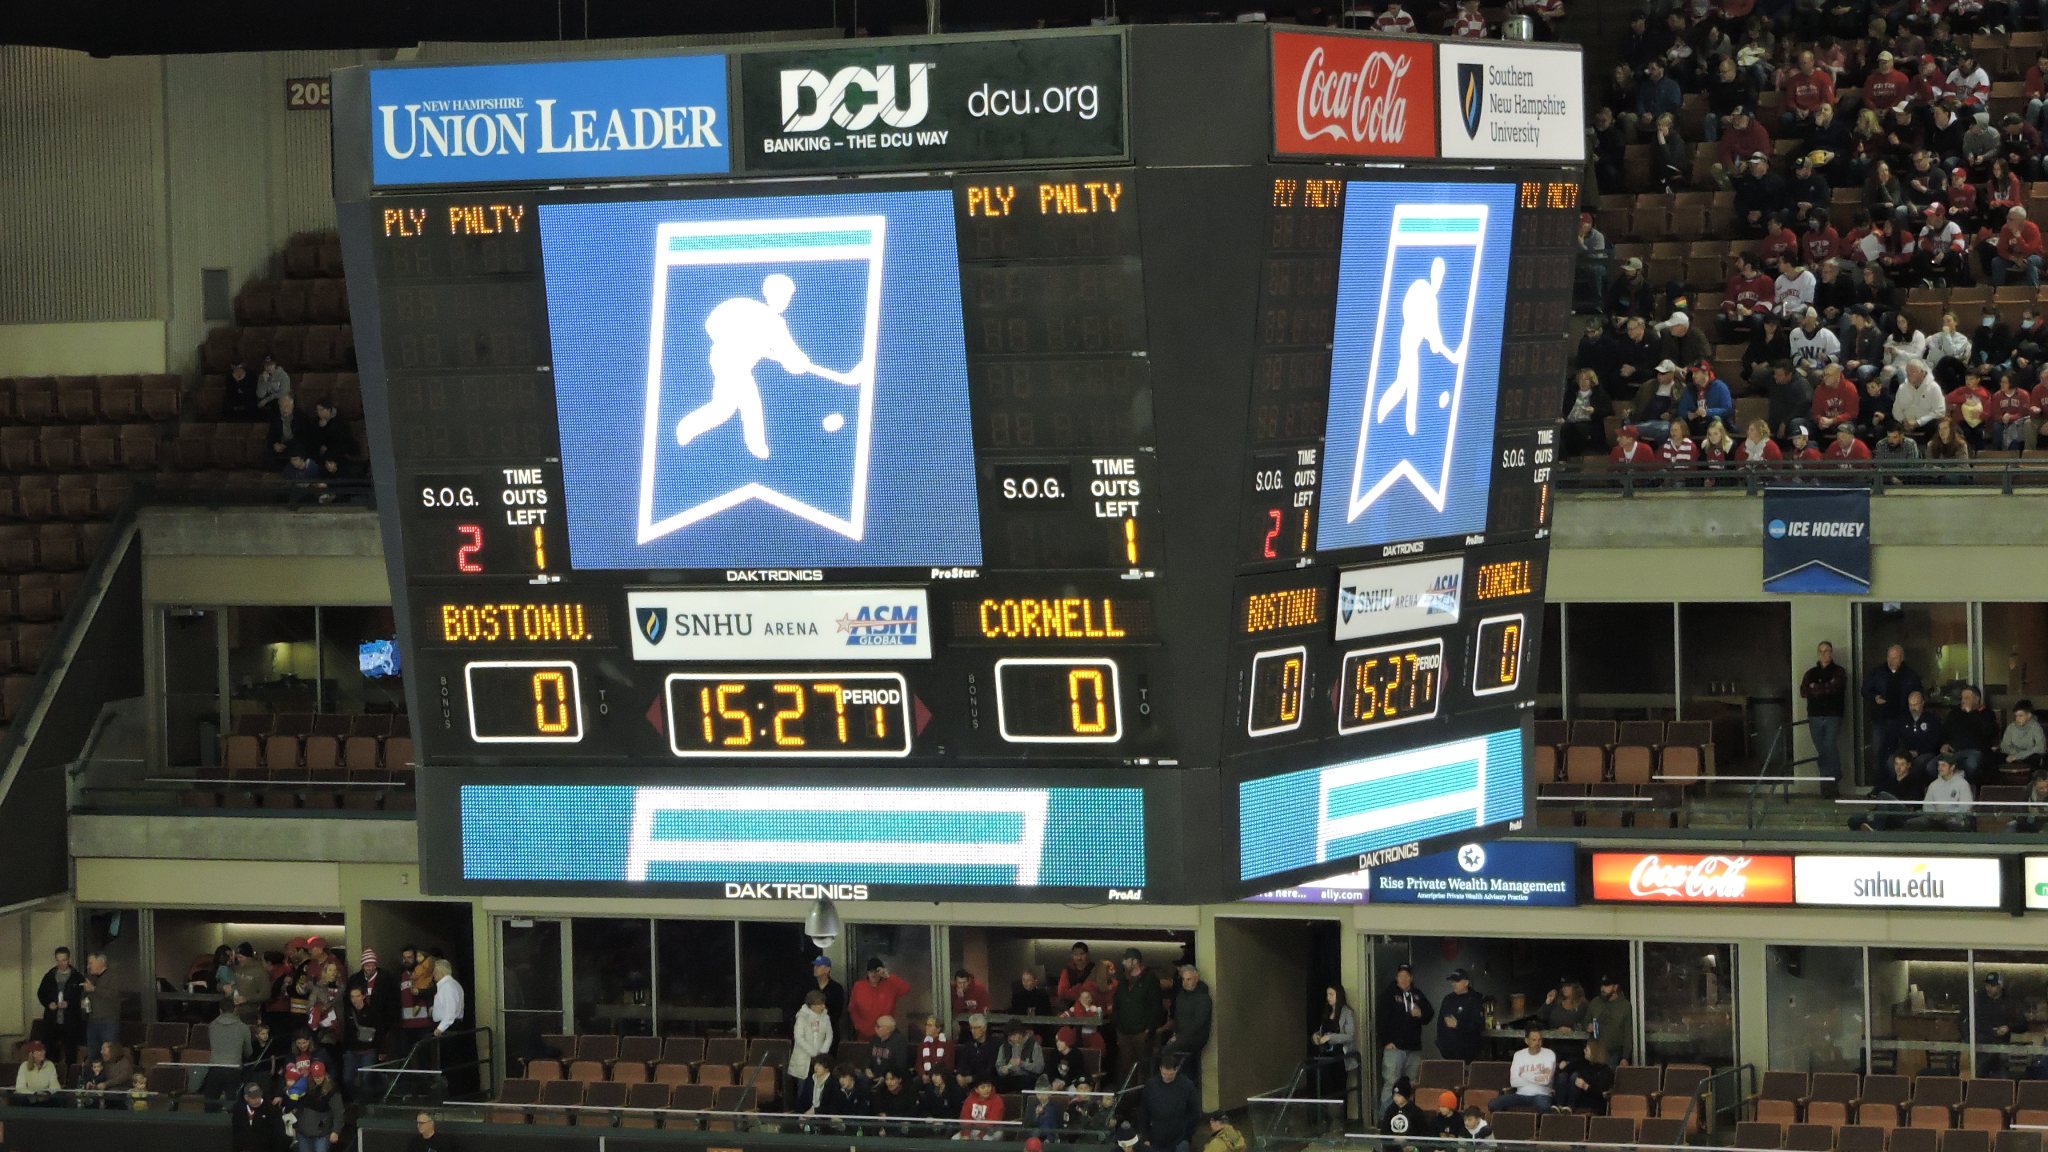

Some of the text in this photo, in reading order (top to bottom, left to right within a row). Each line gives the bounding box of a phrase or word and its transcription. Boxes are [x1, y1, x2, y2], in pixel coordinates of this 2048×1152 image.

[1489, 65, 1533, 87] Southern
[422, 97, 524, 112] NEW HAMPSHIRE
[780, 63, 928, 132] DCU
[967, 82, 1098, 120] dcu.org
[1296, 47, 1412, 144] Coca-Cola
[1490, 93, 1566, 120] New Hampshire
[763, 136, 831, 153] BANKING
[847, 134, 876, 149] THE
[881, 132, 913, 148] DCU
[916, 131, 949, 146] WAY
[1490, 122, 1540, 147] University
[967, 182, 1122, 217] PLY PNLTY
[1273, 179, 1296, 208] PLY
[384, 204, 523, 236] PLY PNLTY
[1538, 430, 1554, 444] TIME
[1092, 458, 1135, 476] TIME
[1298, 449, 1316, 466] TIME
[1502, 449, 1526, 468] S.O.G.
[1534, 448, 1553, 464] OUTS
[503, 468, 542, 485] TIME
[1256, 469, 1283, 492] S.O.G.
[1294, 469, 1316, 487] OUTS
[1534, 467, 1551, 483] LEFT
[423, 487, 479, 507] S.O.G.
[502, 489, 547, 505] OUTS
[1003, 477, 1065, 499] S.O.G.
[1091, 480, 1140, 497] OUTS
[1294, 491, 1314, 508] LEFT
[507, 509, 547, 525] LEFT
[1095, 501, 1139, 518] LEFT
[1125, 518, 1137, 564] 1
[1264, 510, 1281, 558] 2
[1301, 509, 1309, 552] 1
[1788, 522, 1864, 537] ICE HOCKEY
[458, 526, 482, 572] 2
[533, 526, 545, 570] 1
[1383, 541, 1424, 557] DAKTRONICS
[726, 570, 823, 583] DAKTRONICS
[1477, 560, 1531, 599] CORNELL
[1357, 588, 1393, 614] SNHU
[1395, 594, 1417, 608] ARENA
[675, 613, 818, 636] SNHU ARENA
[852, 605, 918, 635] ASM
[980, 599, 1125, 638] CORNELL
[859, 636, 903, 646] GLOBAL
[1416, 654, 1440, 671] PERIOD
[1501, 625, 1518, 682] 0
[842, 690, 900, 705] PERIOD
[1280, 659, 1299, 721] 0
[1354, 653, 1417, 720] 15:27
[533, 671, 567, 732] 0
[1069, 669, 1106, 733] 0
[700, 684, 847, 746] 15:27
[875, 707, 884, 738] 1
[1359, 842, 1420, 870] DAKTRONICS
[1380, 876, 1566, 894] Rise Private Wealth Management
[1628, 854, 1751, 898] Coca-Cola
[1854, 871, 1944, 898] snhu.edu
[725, 883, 868, 900] DAKTRONICS
[1109, 889, 1142, 900] ProAd
[1321, 889, 1363, 901] ally.com
